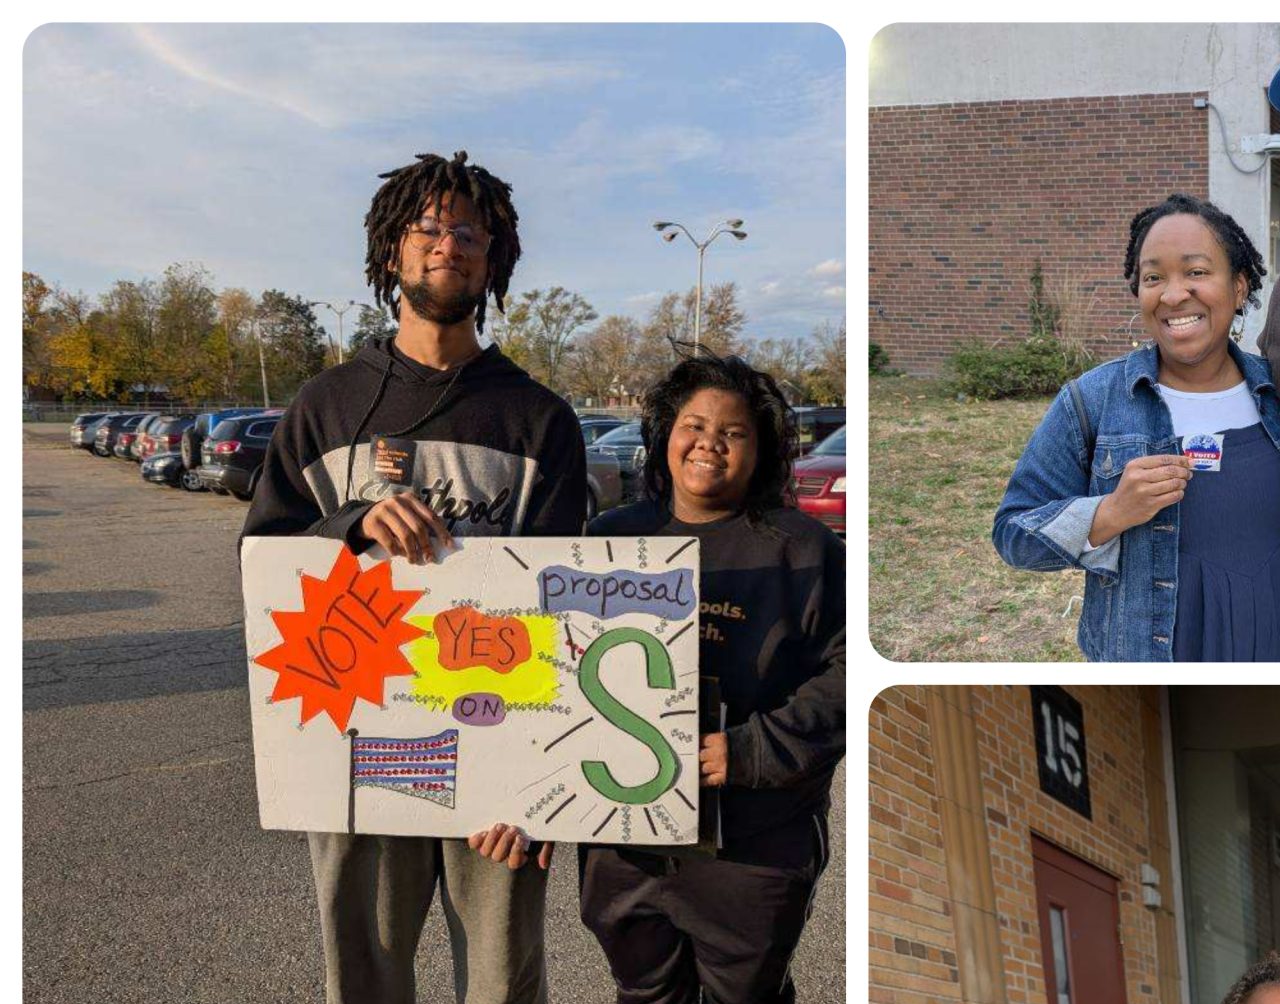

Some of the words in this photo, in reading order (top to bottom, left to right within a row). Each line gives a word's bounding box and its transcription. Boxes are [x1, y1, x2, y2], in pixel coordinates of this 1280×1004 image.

[543, 571, 689, 616] proposal
[700, 602, 746, 620] ools.
[286, 571, 404, 690] VOTE
[443, 614, 516, 666] YES
[461, 697, 499, 718] ON
[578, 627, 682, 806] S
[1041, 701, 1082, 788] 15
